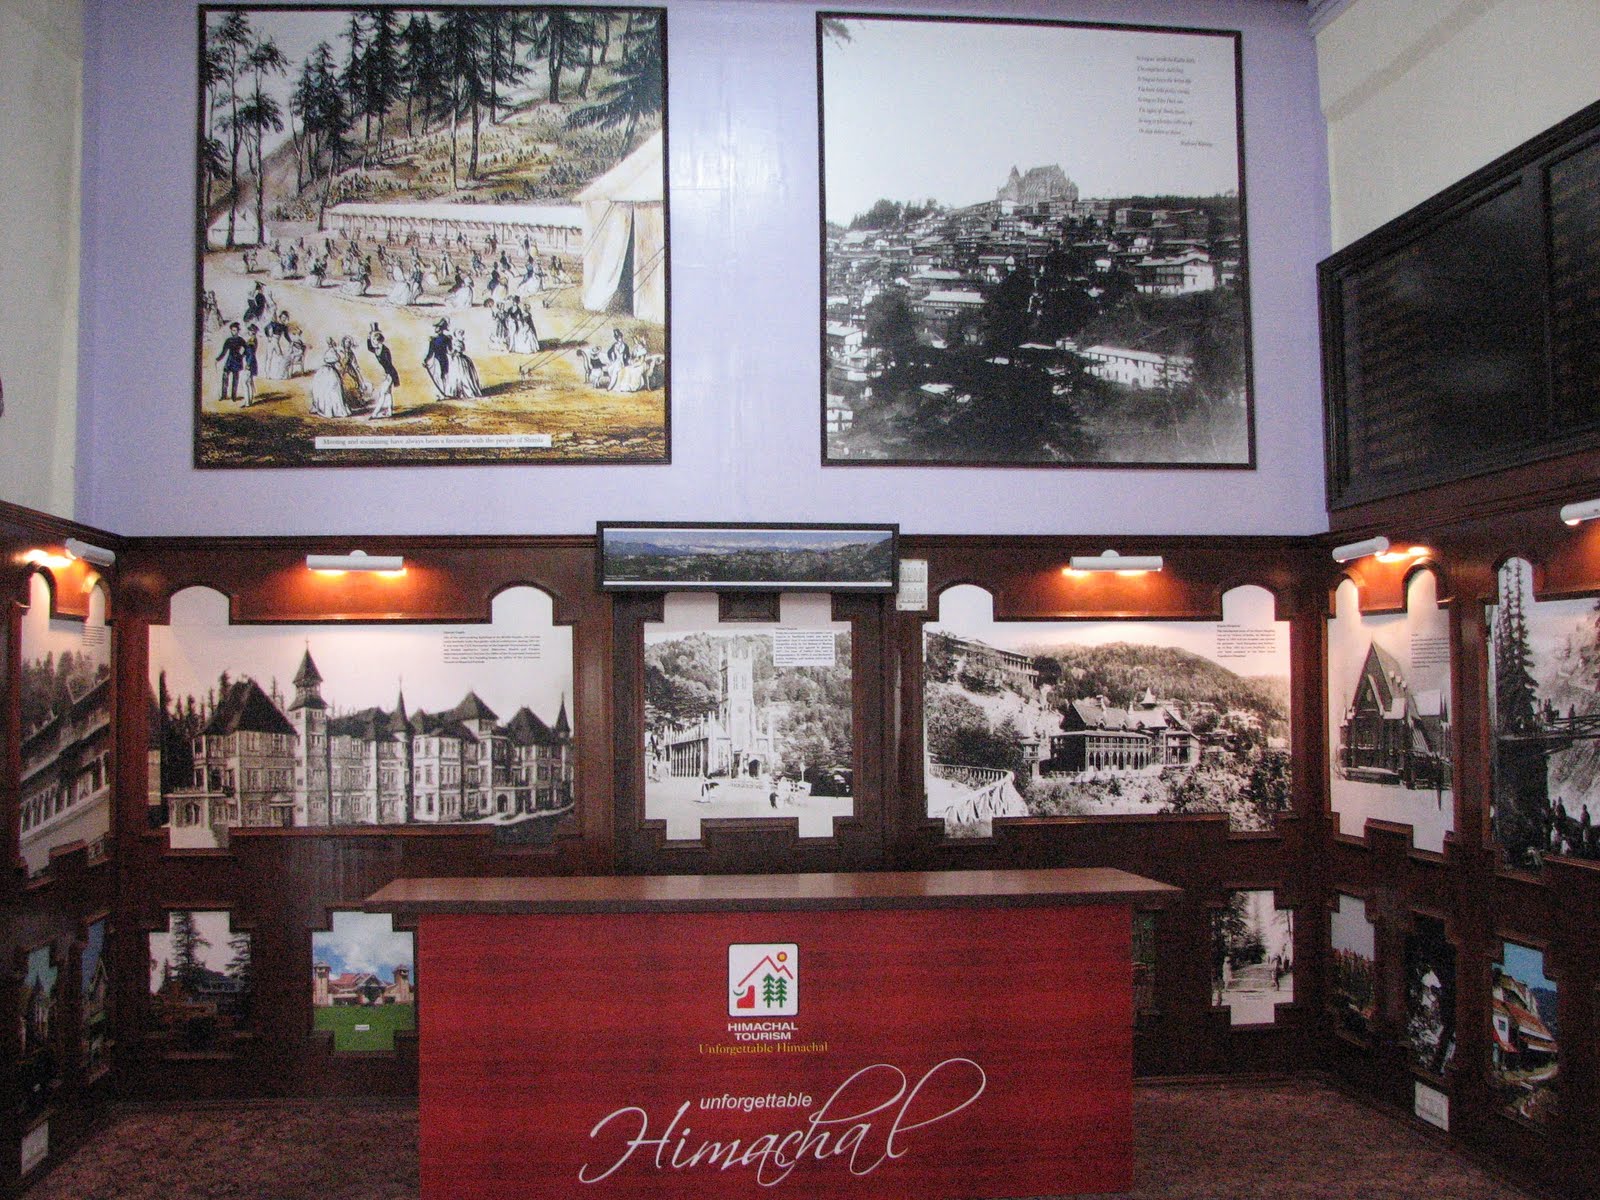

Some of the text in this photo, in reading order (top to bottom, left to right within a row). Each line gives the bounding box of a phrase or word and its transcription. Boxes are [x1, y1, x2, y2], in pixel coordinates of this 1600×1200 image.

[496, 437, 515, 445] people
[727, 1022, 798, 1031] HIMACHAL
[734, 1032, 791, 1041] TOURISM
[699, 1041, 828, 1056] Unforgettable Himachal
[699, 1092, 812, 1112] unforgettable
[578, 1057, 986, 1187] Himachal
